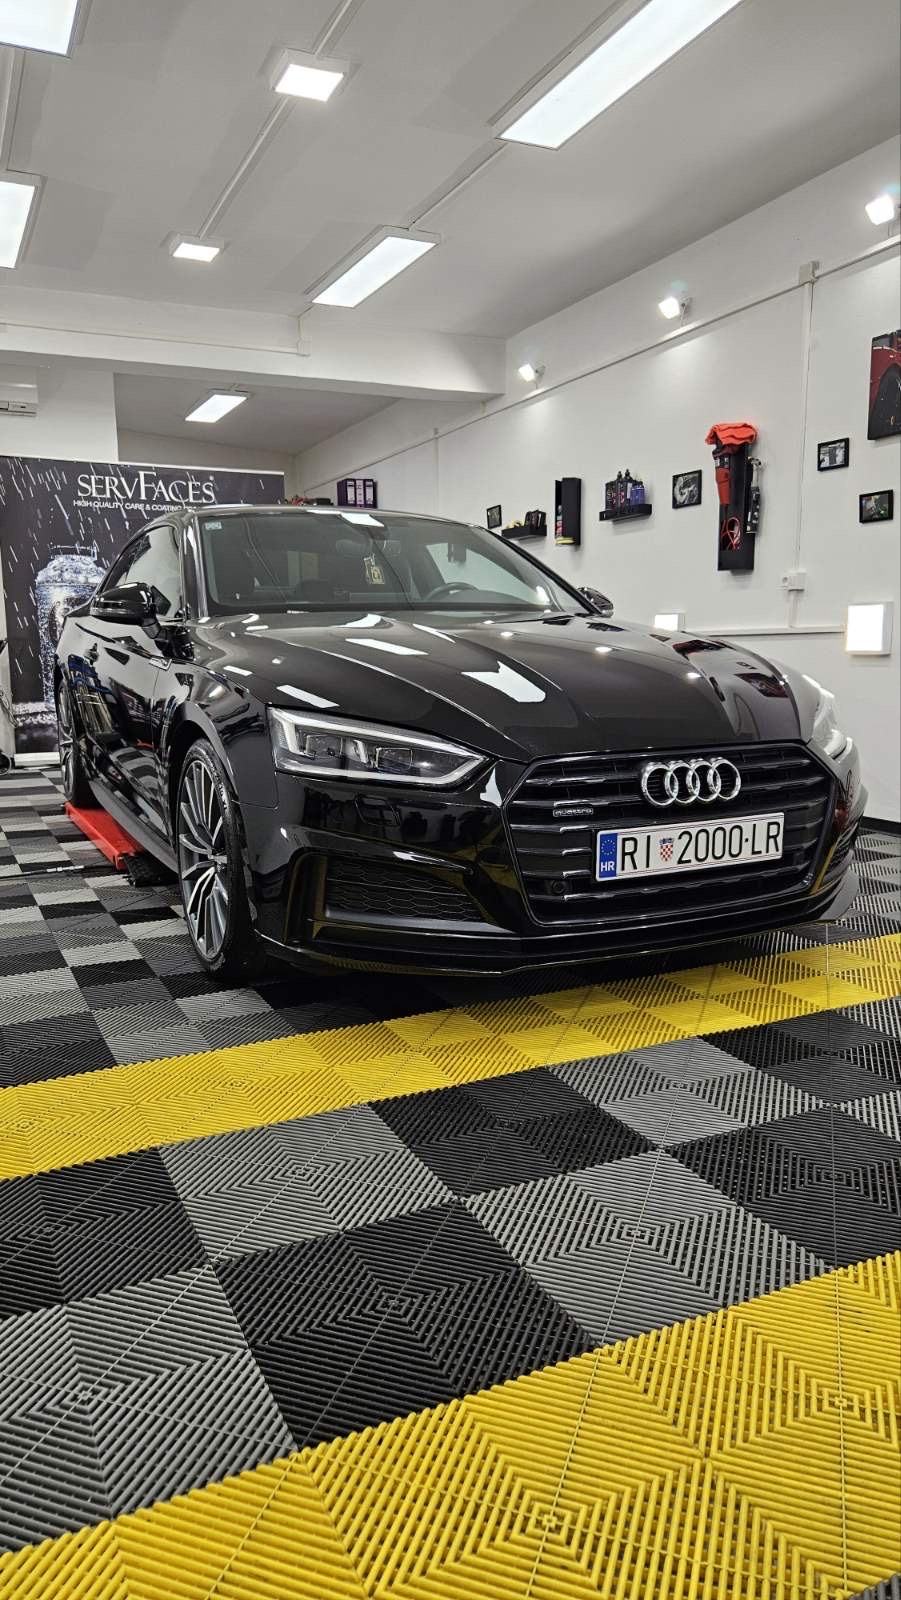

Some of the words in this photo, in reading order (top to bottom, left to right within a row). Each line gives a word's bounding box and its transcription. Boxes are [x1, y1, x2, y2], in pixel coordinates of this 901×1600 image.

[93, 501, 124, 509] QUALITY
[621, 835, 651, 871] RI
[601, 861, 616, 873] HR
